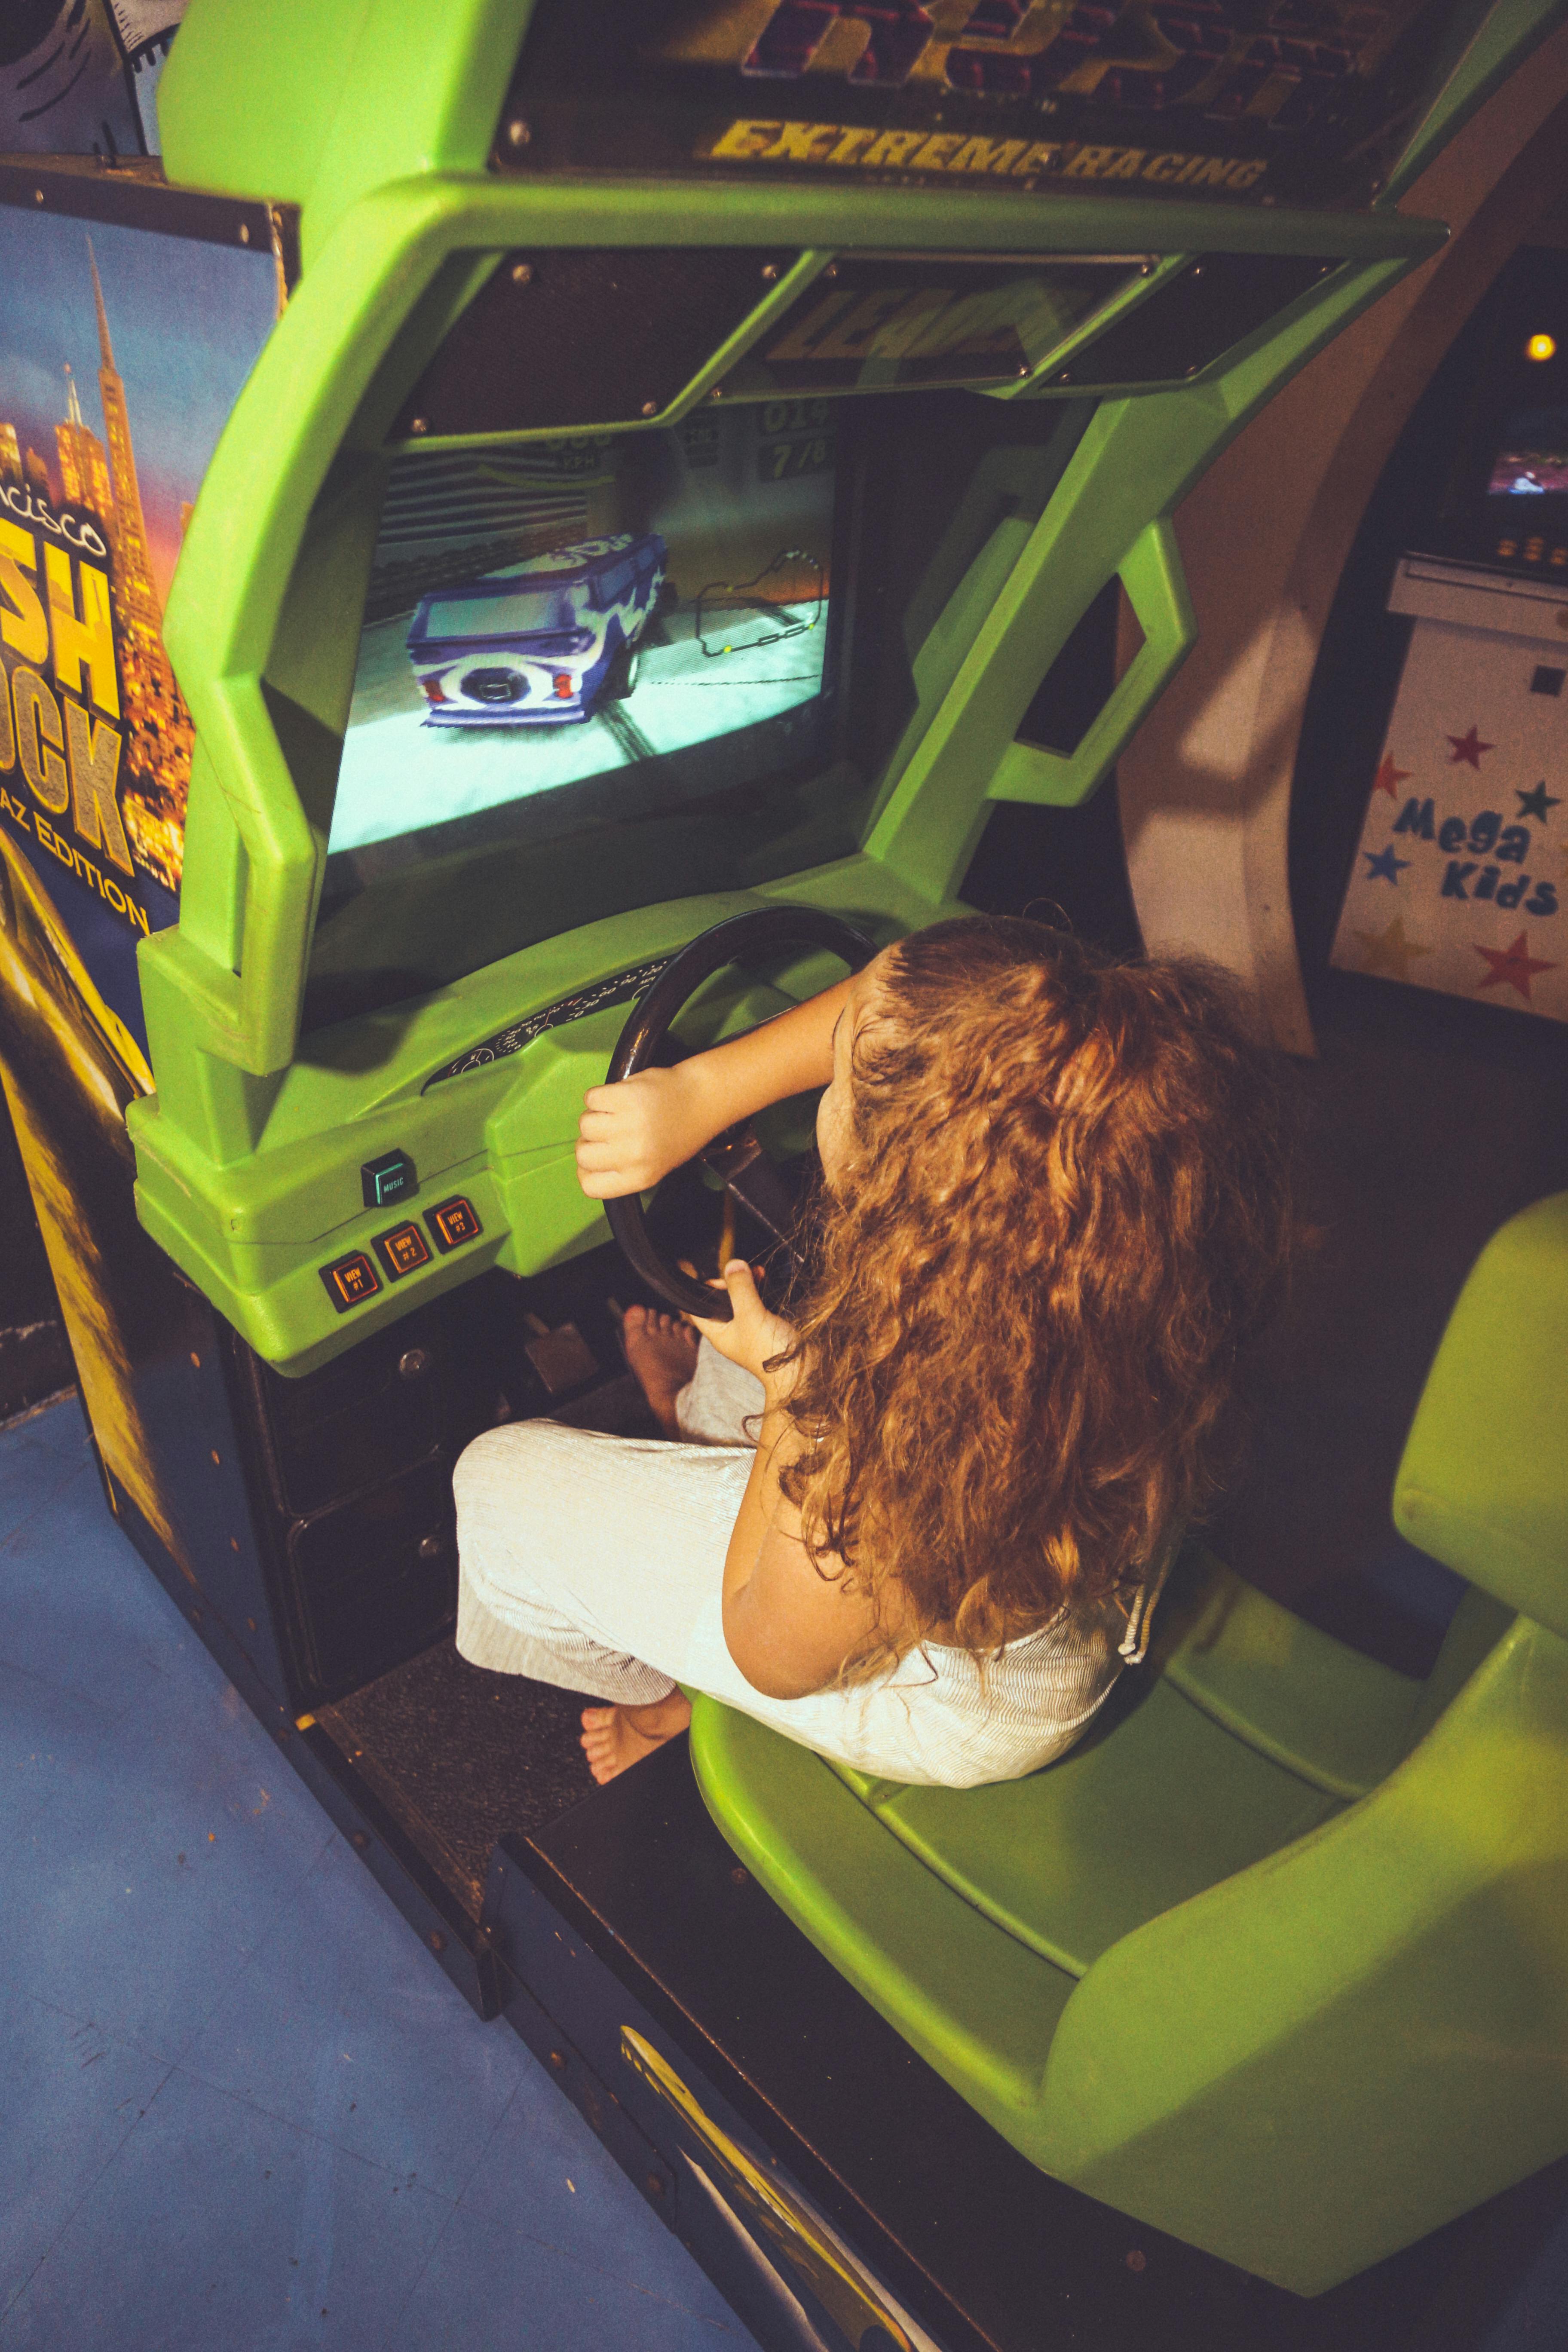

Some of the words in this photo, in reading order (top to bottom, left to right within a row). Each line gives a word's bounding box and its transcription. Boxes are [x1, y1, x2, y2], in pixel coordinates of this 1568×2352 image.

[710, 119, 1063, 175] EXTREME
[1064, 144, 1267, 189] RACING
[1392, 797, 1531, 864] Mega
[33, 811, 150, 936] EDITION
[1440, 861, 1558, 916] Kids
[383, 1177, 404, 1193] MUSIC
[447, 1211, 463, 1225] VIEW
[456, 1222, 466, 1233] #3
[395, 1236, 412, 1251] VIEW
[344, 1268, 361, 1283] VIEW
[353, 1279, 363, 1291] #1
